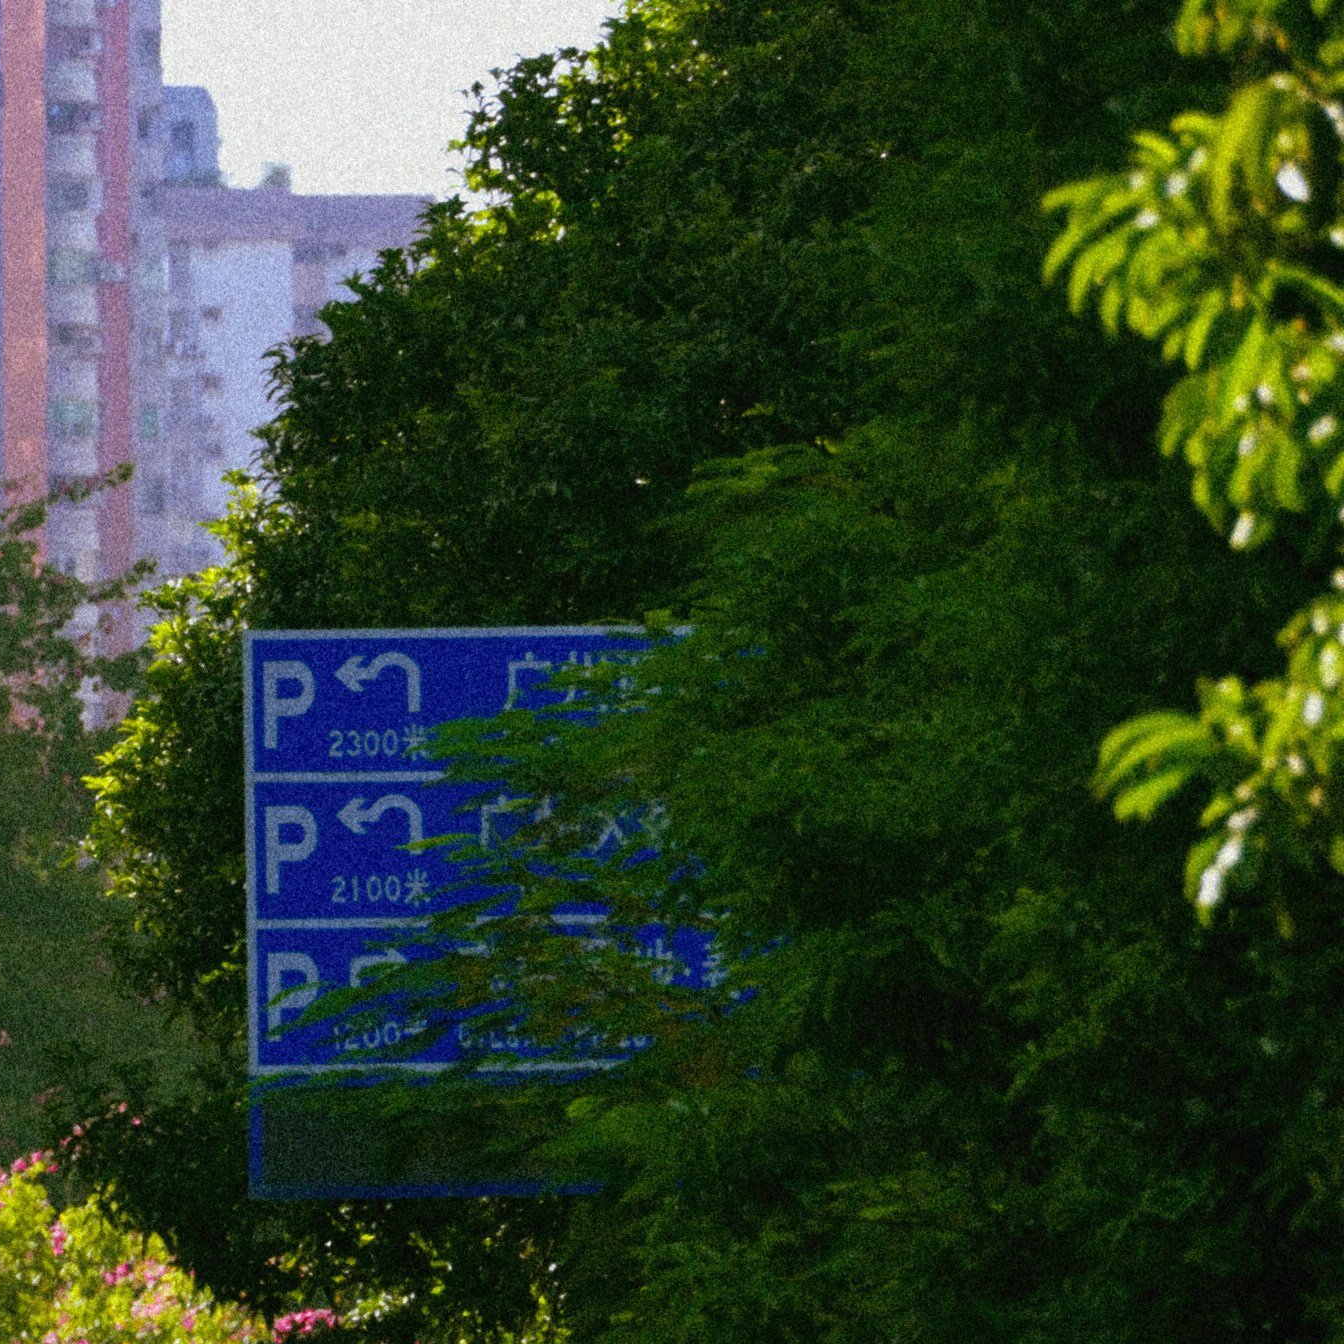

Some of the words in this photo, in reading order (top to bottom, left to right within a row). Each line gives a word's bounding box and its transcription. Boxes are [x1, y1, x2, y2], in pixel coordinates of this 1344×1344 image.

[263, 659, 315, 750] P
[328, 723, 431, 762] 2300米
[265, 804, 318, 895] P
[330, 868, 431, 907] 2100米
[266, 951, 320, 1043] P
[333, 1017, 429, 1052] 1200
